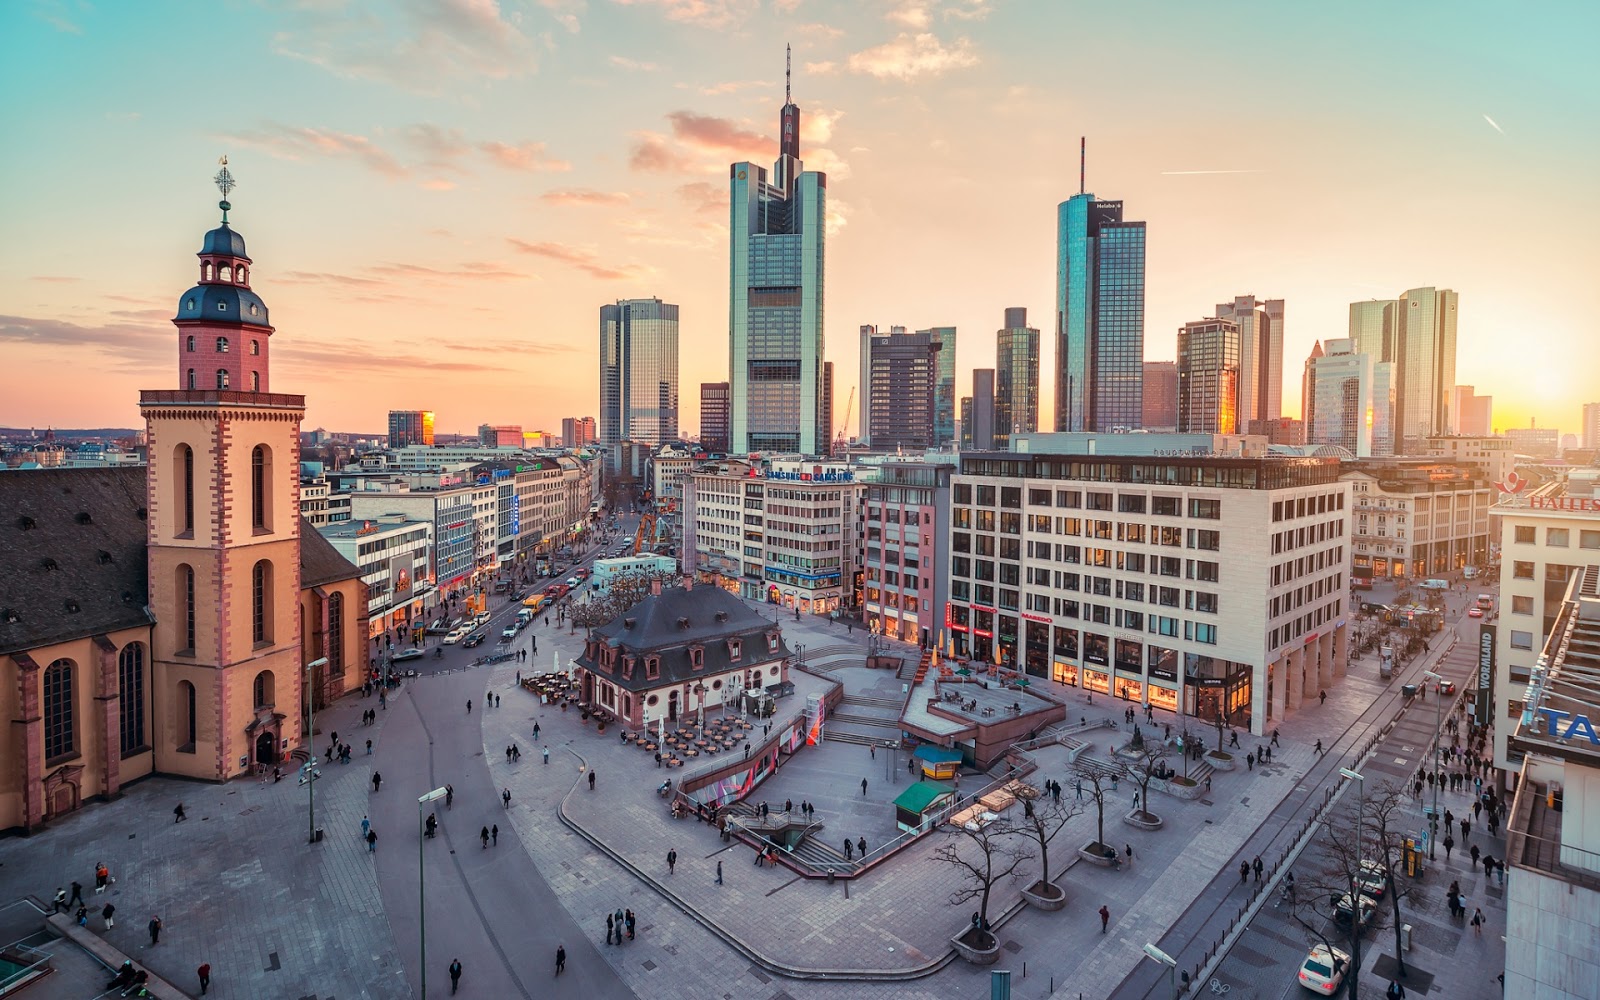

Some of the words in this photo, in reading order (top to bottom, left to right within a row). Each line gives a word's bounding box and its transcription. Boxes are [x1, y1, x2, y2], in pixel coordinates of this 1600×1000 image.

[766, 469, 800, 480] SAMSUNG
[814, 471, 853, 481] SAMSUNG
[1480, 632, 1492, 689] WORMLAND
[1538, 706, 1600, 745] TA
